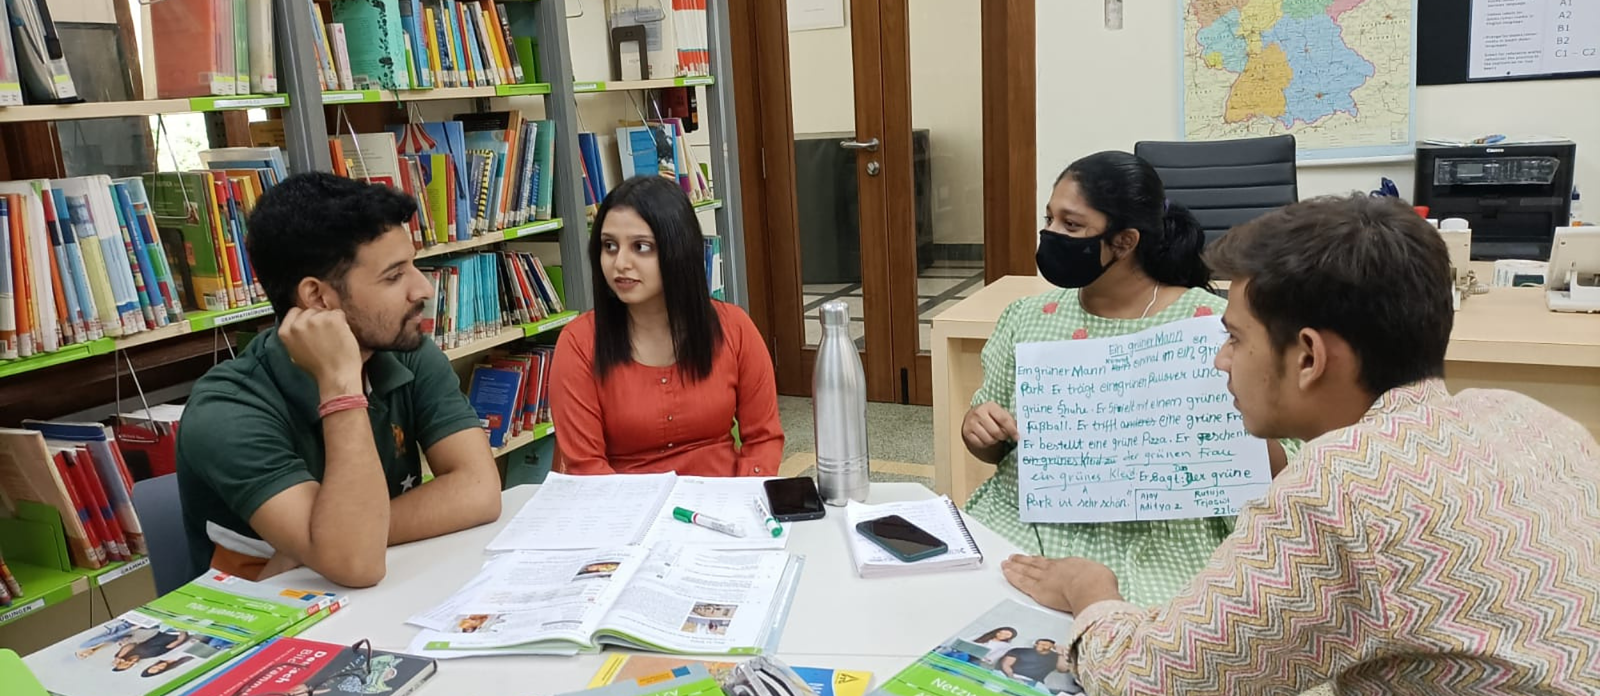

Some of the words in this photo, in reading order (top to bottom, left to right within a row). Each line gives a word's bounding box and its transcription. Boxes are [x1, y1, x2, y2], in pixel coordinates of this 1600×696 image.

[1558, 11, 1572, 19] A2
[1557, 24, 1569, 32] B1
[1556, 36, 1569, 45] B2
[1555, 49, 1567, 57] C1
[1582, 48, 1596, 56] C2
[1156, 330, 1183, 346] Mann
[1072, 365, 1106, 377] Mann
[1020, 381, 1044, 397] Park
[1052, 384, 1061, 394] Er
[1022, 404, 1052, 419] grüne
[1096, 402, 1106, 414] Er
[1186, 393, 1228, 410] grünen
[1077, 420, 1088, 431] Er
[1186, 413, 1222, 430] grüne
[1023, 440, 1034, 449] Er
[1039, 436, 1084, 451] bestellt
[1088, 439, 1108, 450] eine
[1176, 432, 1190, 443] Er
[1031, 472, 1055, 481] ein
[1140, 471, 1149, 482] Er
[1211, 469, 1252, 487] grüne
[1026, 492, 1052, 511] Park
